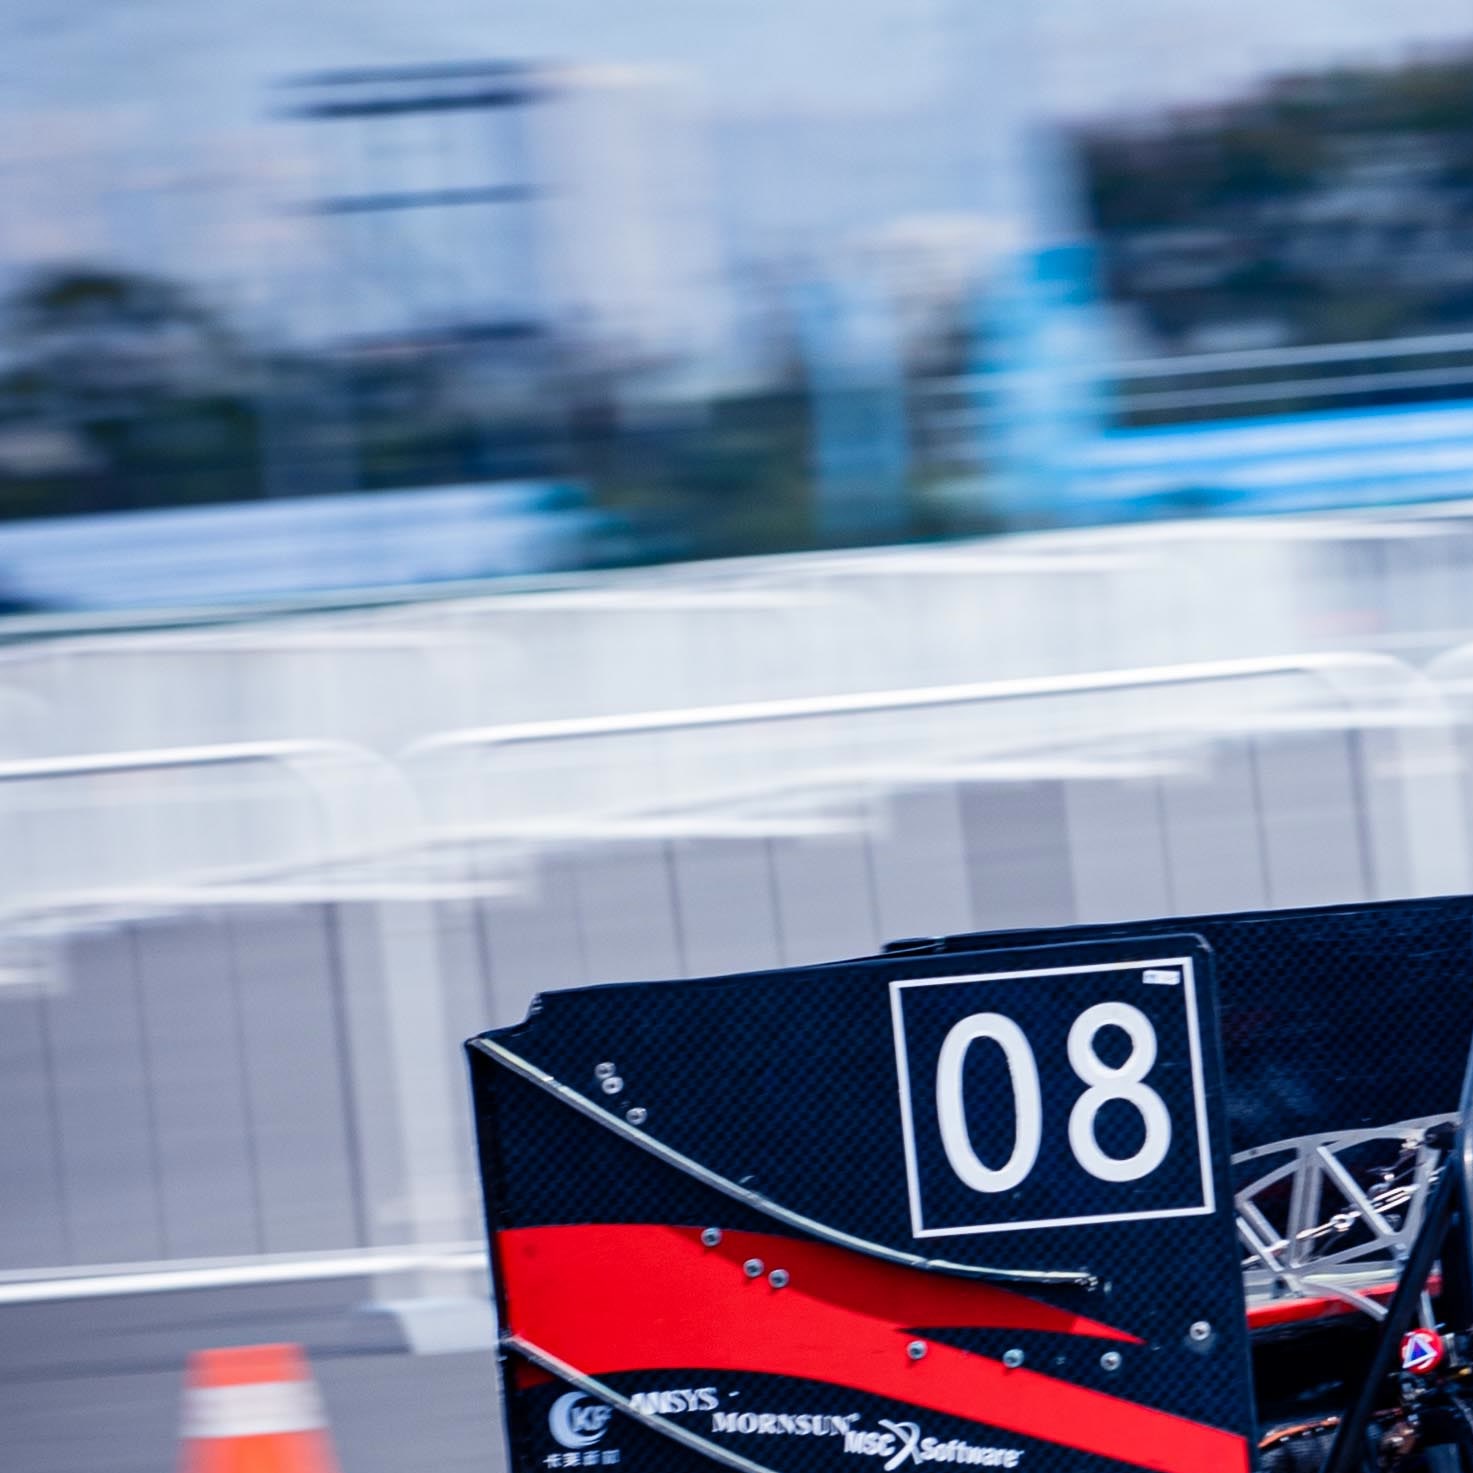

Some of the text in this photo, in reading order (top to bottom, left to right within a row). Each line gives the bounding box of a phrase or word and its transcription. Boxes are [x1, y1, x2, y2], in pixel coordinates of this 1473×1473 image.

[934, 1001, 1173, 1194] 08
[711, 1412, 852, 1437] MORNSUN
[843, 1430, 1022, 1469] MSC Software
